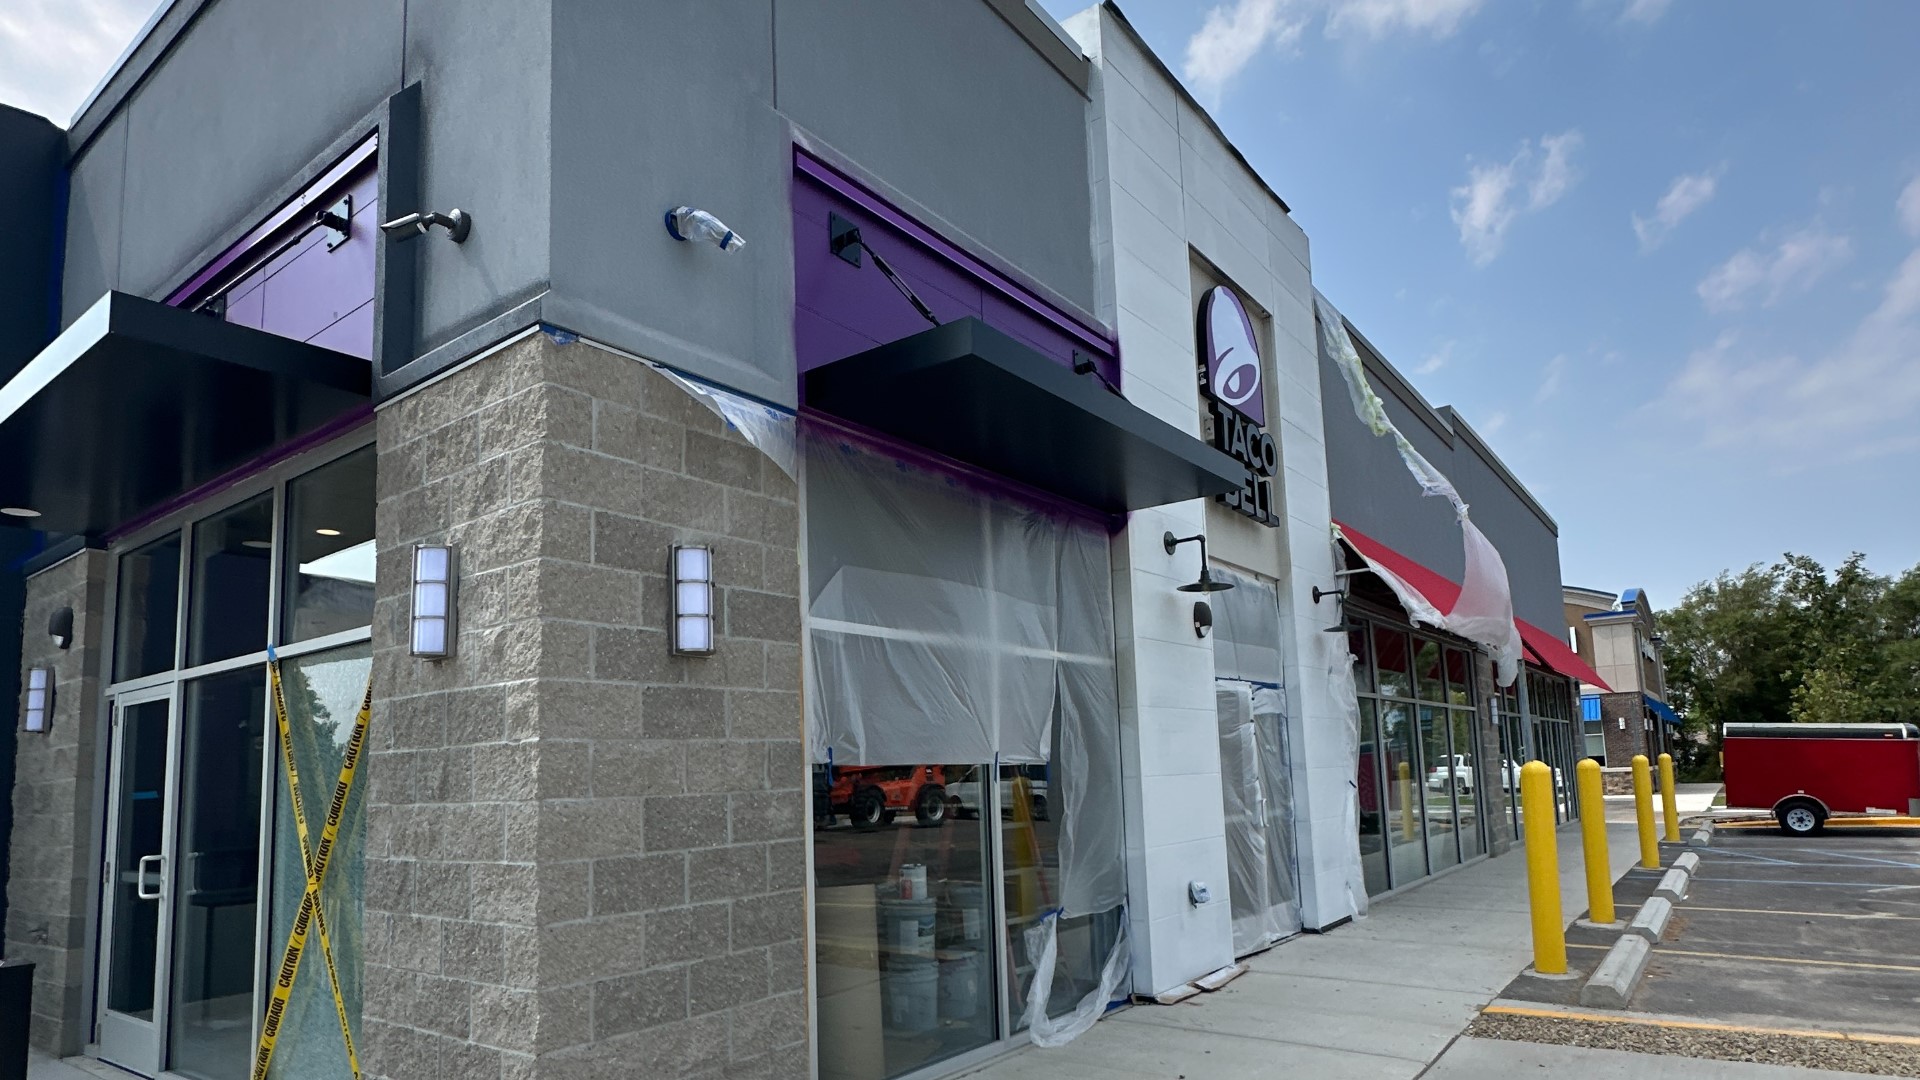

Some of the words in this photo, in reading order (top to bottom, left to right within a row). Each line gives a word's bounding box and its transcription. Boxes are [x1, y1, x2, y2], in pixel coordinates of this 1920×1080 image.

[1217, 401, 1278, 477] TACO
[344, 723, 365, 770] CAUTION
[312, 889, 326, 937] CAUTION
[265, 997, 285, 1037] CUIDADO
[279, 947, 300, 988] CAUTION
